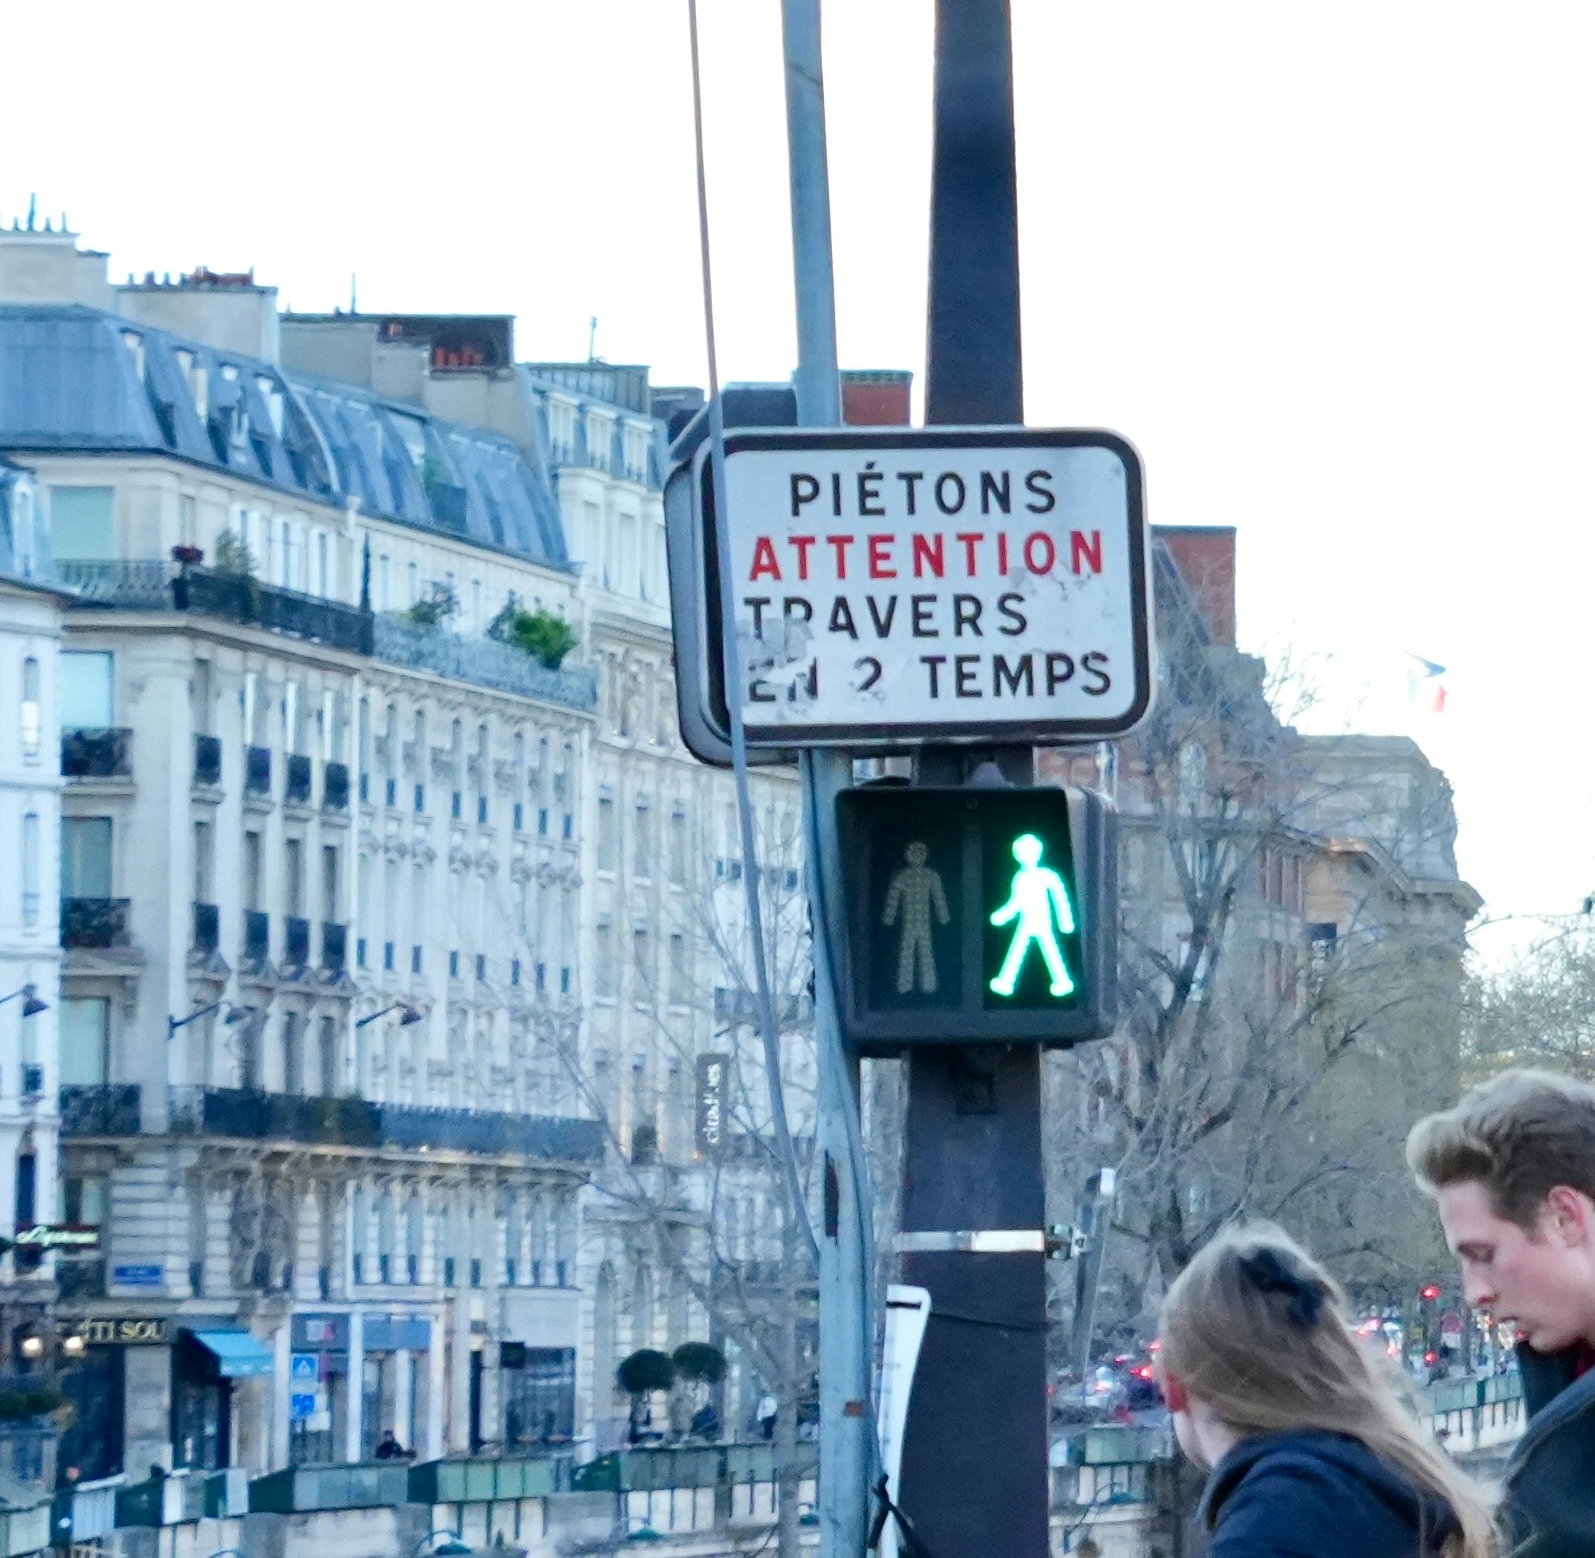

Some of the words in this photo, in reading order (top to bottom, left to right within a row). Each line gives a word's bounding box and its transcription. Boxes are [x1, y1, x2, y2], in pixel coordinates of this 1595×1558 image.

[790, 461, 1057, 518] PIÉTONS
[748, 529, 1104, 581] ATTENTION
[919, 650, 1113, 699] TEMPS
